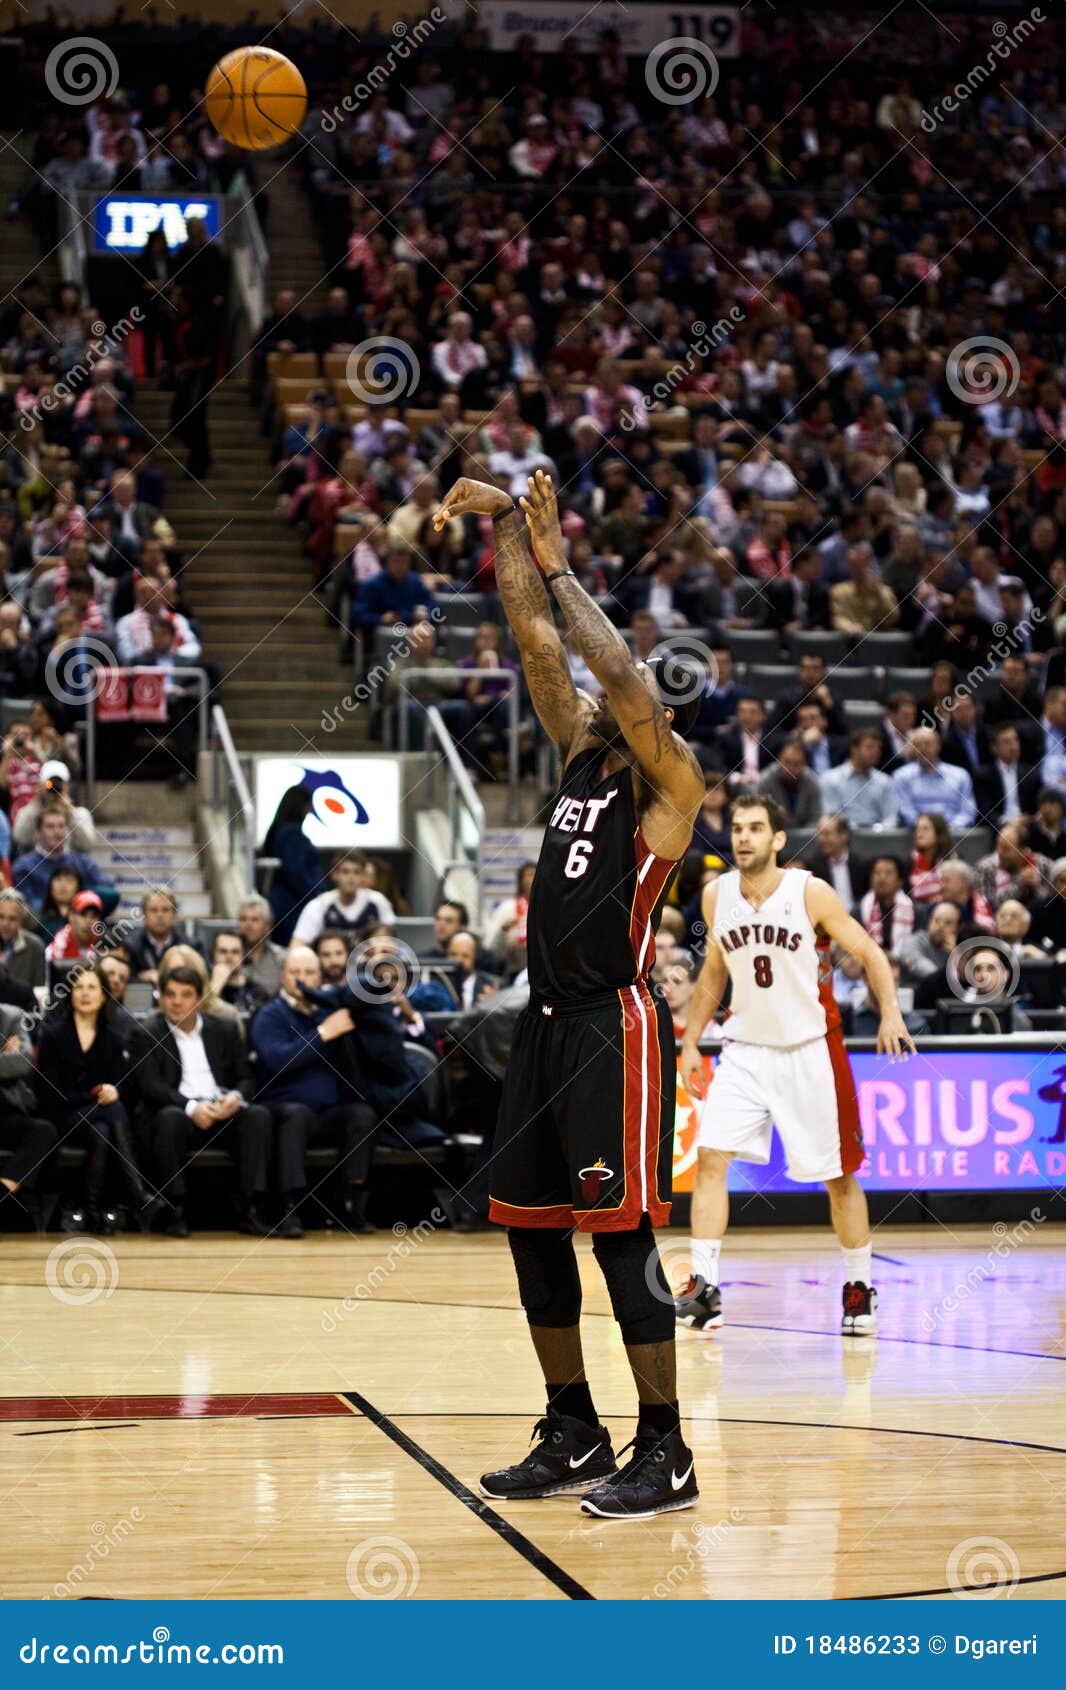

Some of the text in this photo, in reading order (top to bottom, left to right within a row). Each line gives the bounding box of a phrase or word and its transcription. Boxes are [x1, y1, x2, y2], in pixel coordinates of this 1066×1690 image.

[669, 13, 735, 48] 119
[564, 839, 594, 879] 6
[753, 955, 773, 988] 8
[859, 1080, 1034, 1146] RIUS
[857, 1150, 1066, 1177] ELLITE RAD
